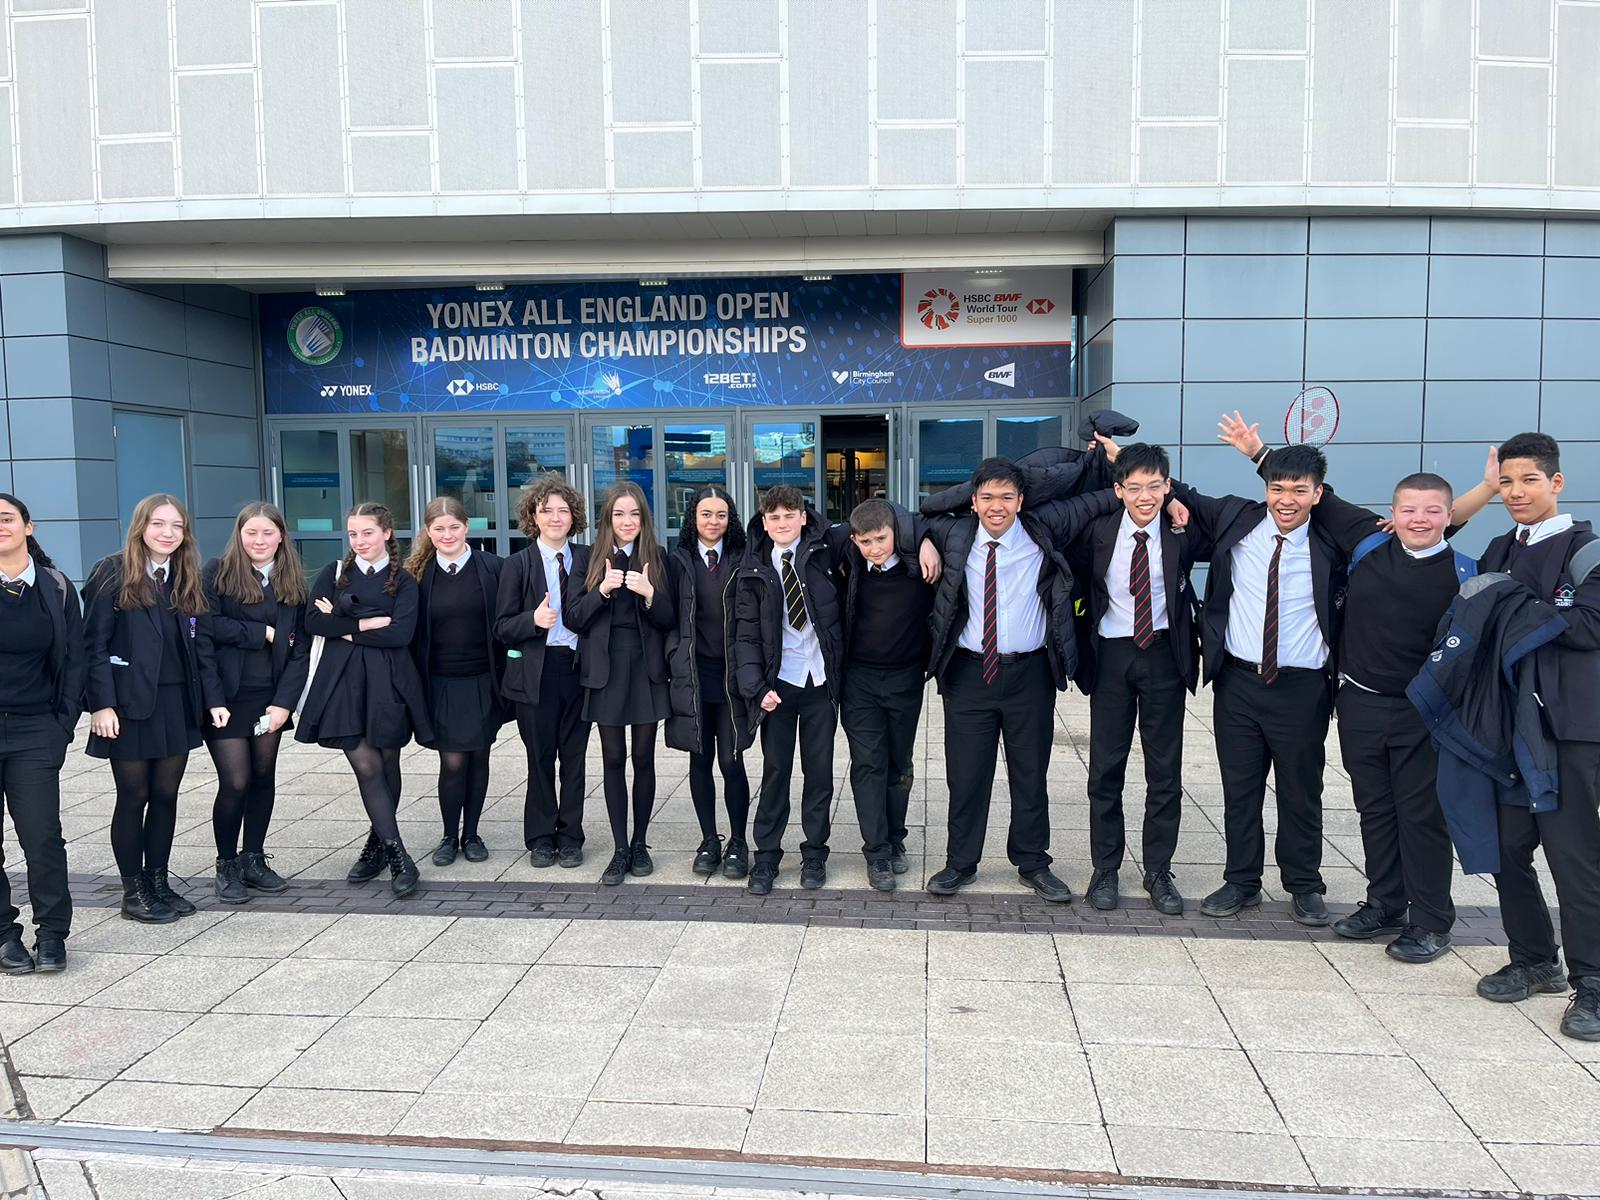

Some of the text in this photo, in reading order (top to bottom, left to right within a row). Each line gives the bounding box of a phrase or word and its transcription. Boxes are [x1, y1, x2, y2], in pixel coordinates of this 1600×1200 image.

[963, 293, 1022, 302] HSBC BWF
[426, 292, 789, 329] YONEX ALL ENGLAND OPEN
[966, 304, 1018, 313] World Tour
[966, 314, 1018, 325] Super 1000
[411, 325, 807, 363] BADMINTON CHAMPIONSHIPS
[703, 373, 751, 384] 12BET
[852, 370, 895, 379] Birmingham
[988, 371, 1013, 379] BWF
[852, 377, 865, 386] City
[340, 385, 371, 396] YONEX
[475, 383, 499, 391] HSBC
